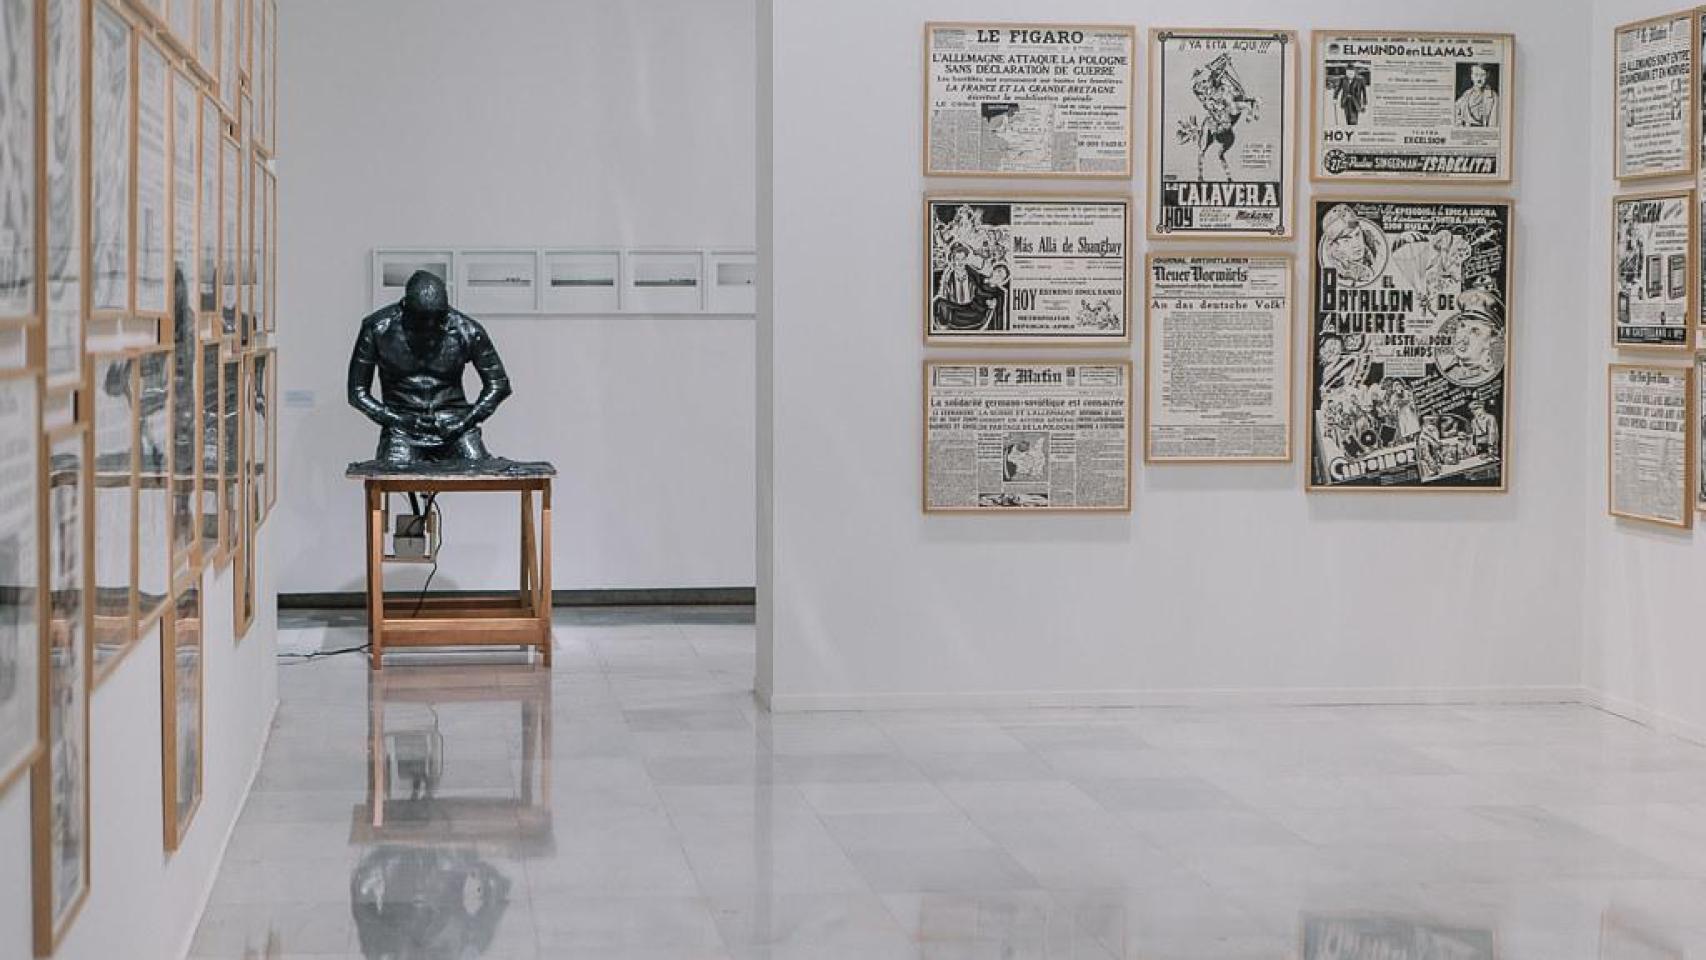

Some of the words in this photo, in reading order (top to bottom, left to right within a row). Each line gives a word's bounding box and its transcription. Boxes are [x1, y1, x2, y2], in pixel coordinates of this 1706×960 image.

[977, 30, 1000, 43] LE
[1009, 30, 1084, 44] FIGARO
[1357, 45, 1405, 57] MUNDO
[1421, 46, 1474, 58] LLAMAS
[932, 53, 1005, 64] L'ALLEMAGNE
[1008, 54, 1059, 65] ATTAQUE
[1062, 55, 1076, 65] LA
[1079, 56, 1128, 66] POLOGNE
[944, 64, 972, 74] SANS
[1054, 66, 1069, 76] DE
[1073, 66, 1116, 76] GUERRE
[945, 84, 958, 93] LA
[960, 84, 997, 93] FRANCE
[999, 84, 1011, 93] ET
[1013, 84, 1026, 93] LA
[1323, 131, 1354, 143] HOY
[1178, 183, 1278, 206] CALAVERA
[1164, 206, 1194, 228] HOY
[1013, 235, 1034, 253] Más
[1062, 235, 1074, 253] de
[1152, 266, 1190, 282] Neuer
[1190, 266, 1249, 282] Vorwärts
[1383, 275, 1395, 288] EL
[1322, 268, 1414, 312] BATALLON
[1437, 293, 1454, 310] DE
[1012, 288, 1037, 311] HOY
[1151, 299, 1168, 309] An
[1199, 299, 1249, 309] deutsche
[1337, 312, 1406, 334] MUERTE
[994, 367, 1011, 384] Le
[1014, 367, 1063, 384] Matin
[931, 396, 942, 407] La
